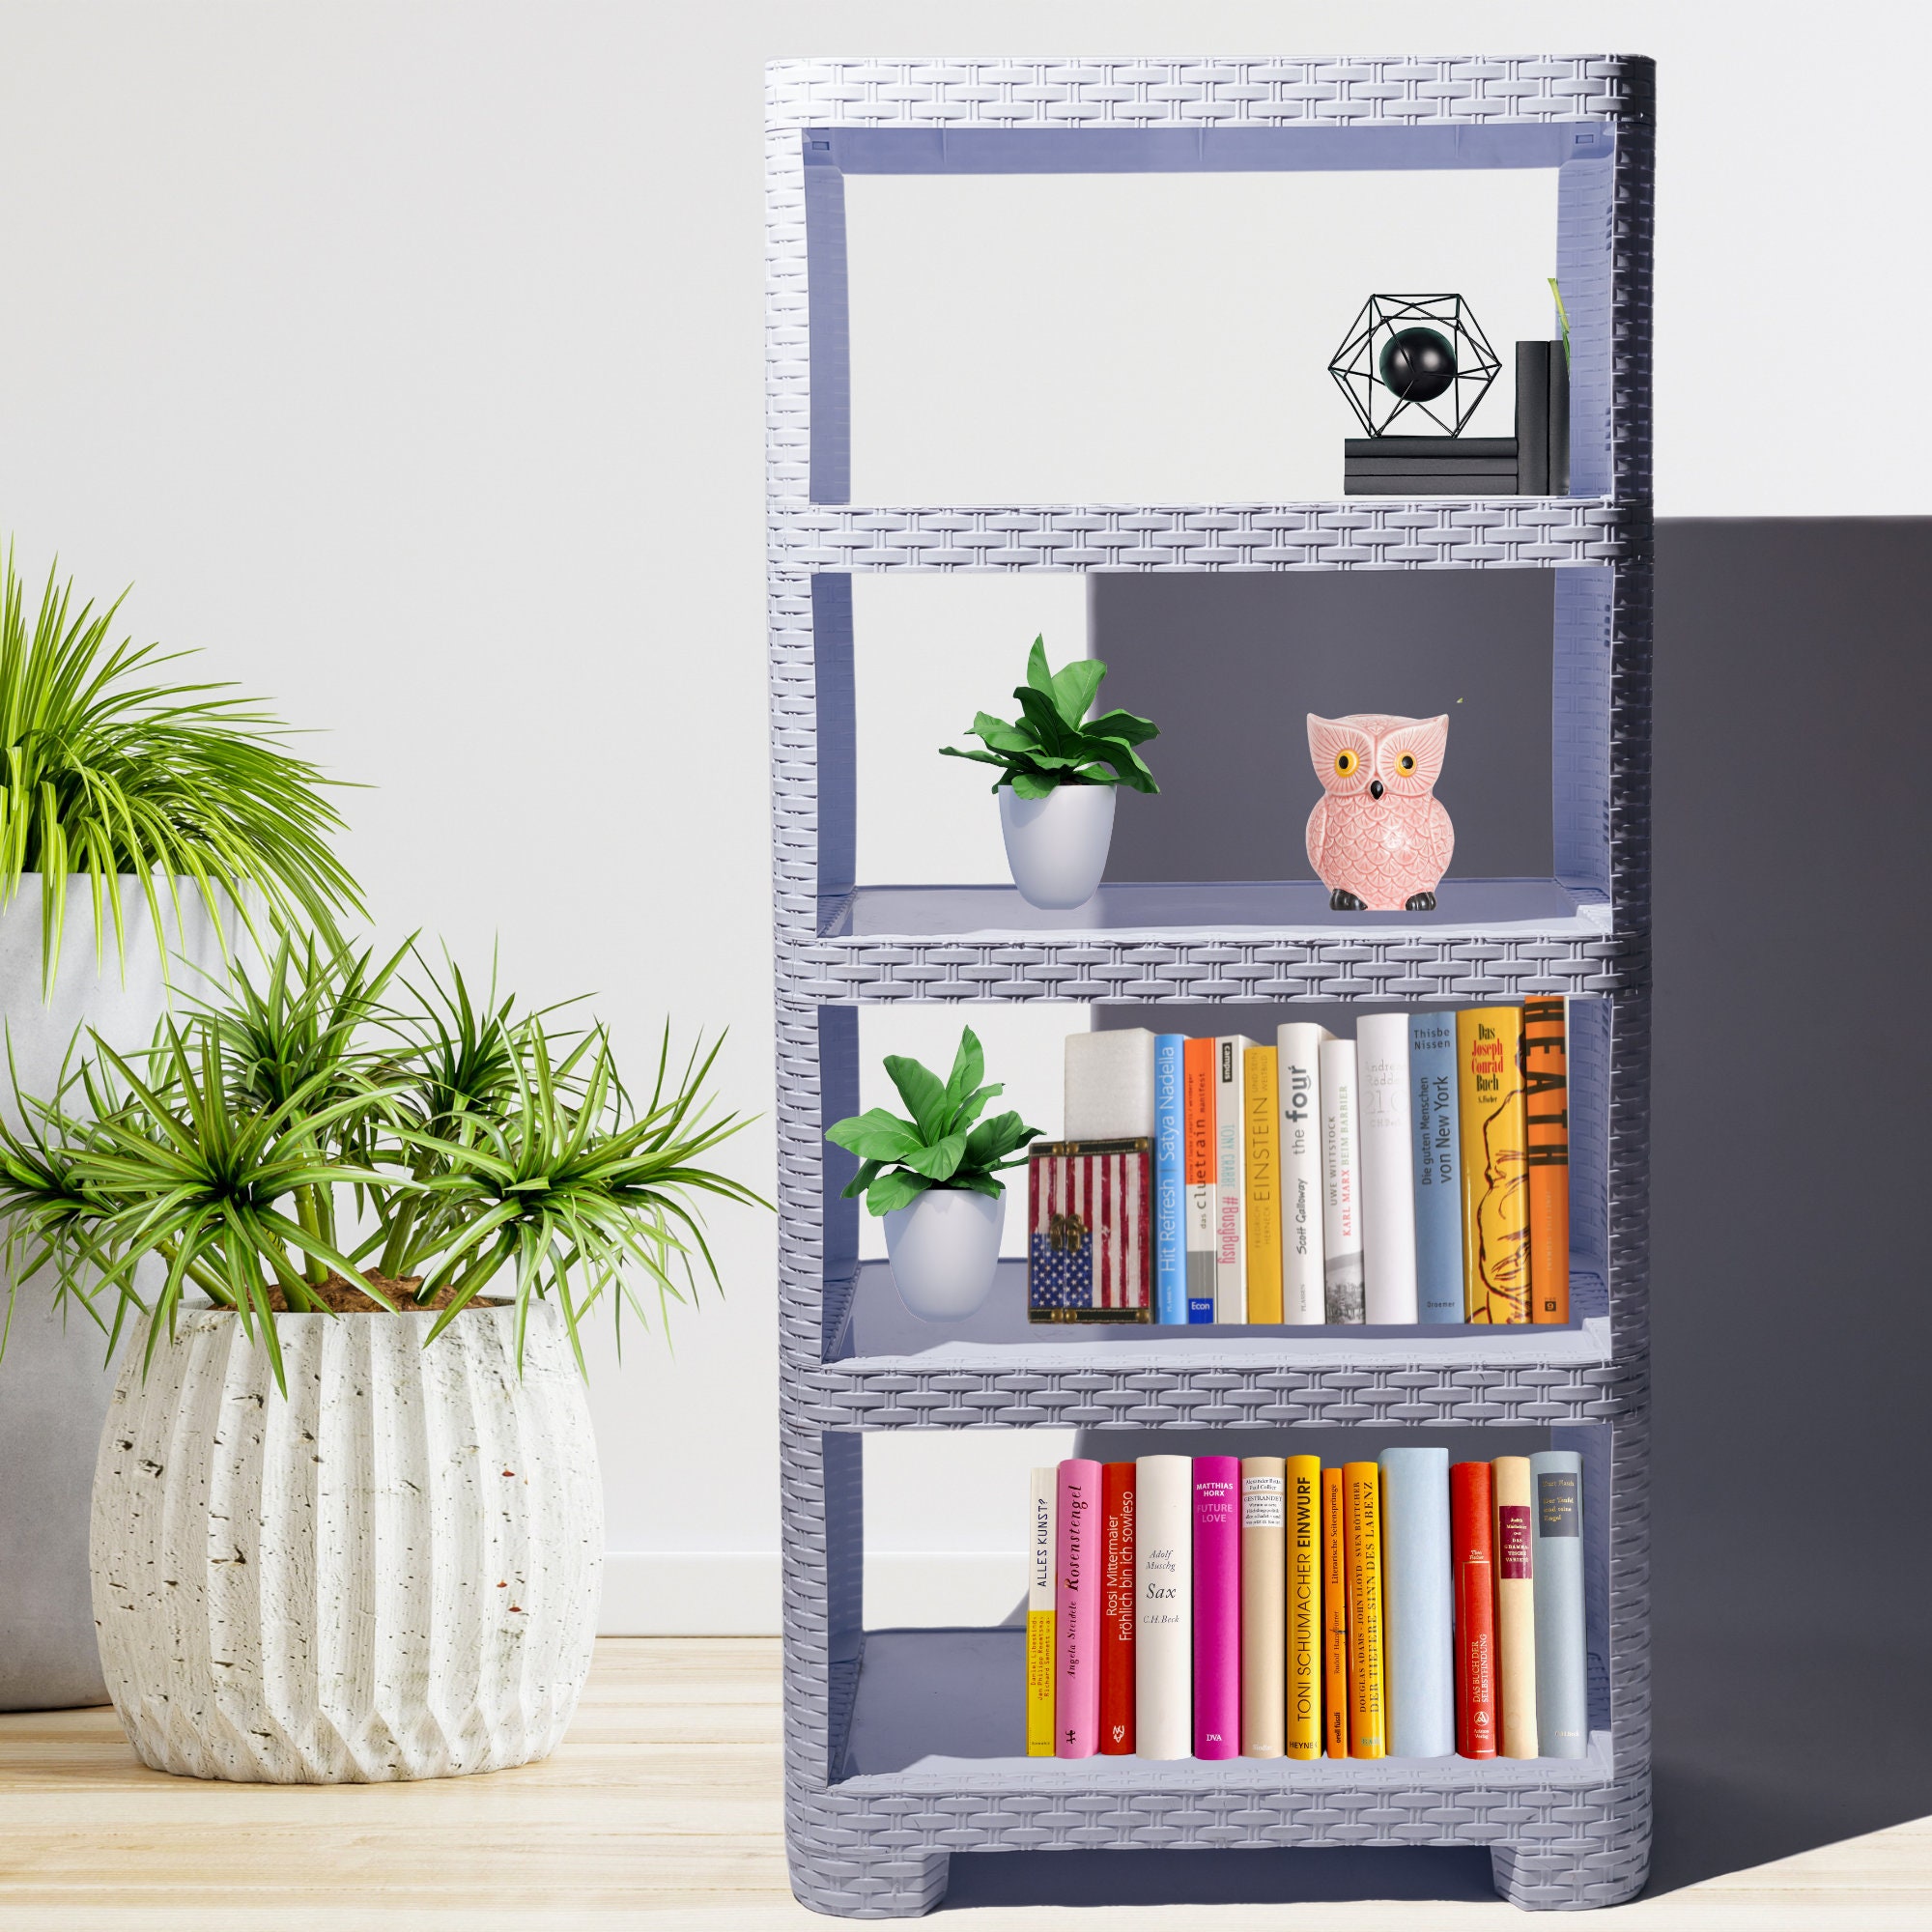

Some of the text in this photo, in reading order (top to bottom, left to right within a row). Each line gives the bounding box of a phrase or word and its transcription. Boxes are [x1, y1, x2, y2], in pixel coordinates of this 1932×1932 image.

[1413, 1027, 1450, 1038] Thisbe
[1414, 1040, 1451, 1050] Nissen
[1471, 1037, 1503, 1061] Joseph
[1478, 1023, 1495, 1040] Das
[1471, 1056, 1503, 1074] Conrad
[1476, 1073, 1499, 1092] Buch
[1525, 1001, 1569, 1166] HEATH
[1158, 1047, 1179, 1161] Satya Nadella
[1285, 1065, 1311, 1154] the four
[1339, 1086, 1349, 1133] BARBIER
[1418, 1077, 1434, 1184] Die guten Menschen
[1432, 1076, 1452, 1183] von New York
[1194, 1120, 1207, 1209] cluetrain
[1221, 1123, 1235, 1187] TONY CRABBE
[1253, 1097, 1270, 1201] EINSTEIN
[1328, 1116, 1337, 1178] WITTSTOCK
[1340, 1137, 1350, 1165] BEIM
[1159, 1179, 1175, 1271] Hit Refresh
[1218, 1197, 1238, 1264] #BusyBusy
[1295, 1179, 1309, 1254] Scott Galloway
[1342, 1207, 1350, 1236] KARL
[1191, 1301, 1210, 1311] Econ
[1196, 1482, 1234, 1491] MATTHIAS
[1197, 1503, 1234, 1514] FUTURE
[1202, 1514, 1227, 1523] LOVE
[1037, 1499, 1047, 1587] ALLES KUNST?
[1065, 1485, 1088, 1591] Rosenstengel
[1106, 1516, 1118, 1616] Rosi Mittermaier
[1119, 1492, 1133, 1641] Fröhlich bin ich sowieso
[1146, 1561, 1176, 1572] Muschg
[1150, 1549, 1173, 1562] Adolf
[1143, 1614, 1179, 1624] C.H.Beck
[1146, 1582, 1177, 1599] Sax
[1296, 1476, 1311, 1721] TONI SCHUMACHER EINWURF
[1364, 1482, 1379, 1713] DER TIEFERE SINN DES LABENZ
[1066, 1601, 1079, 1679] Angela Steidele
[1480, 1634, 1489, 1702] SELBSTFINDUNG
